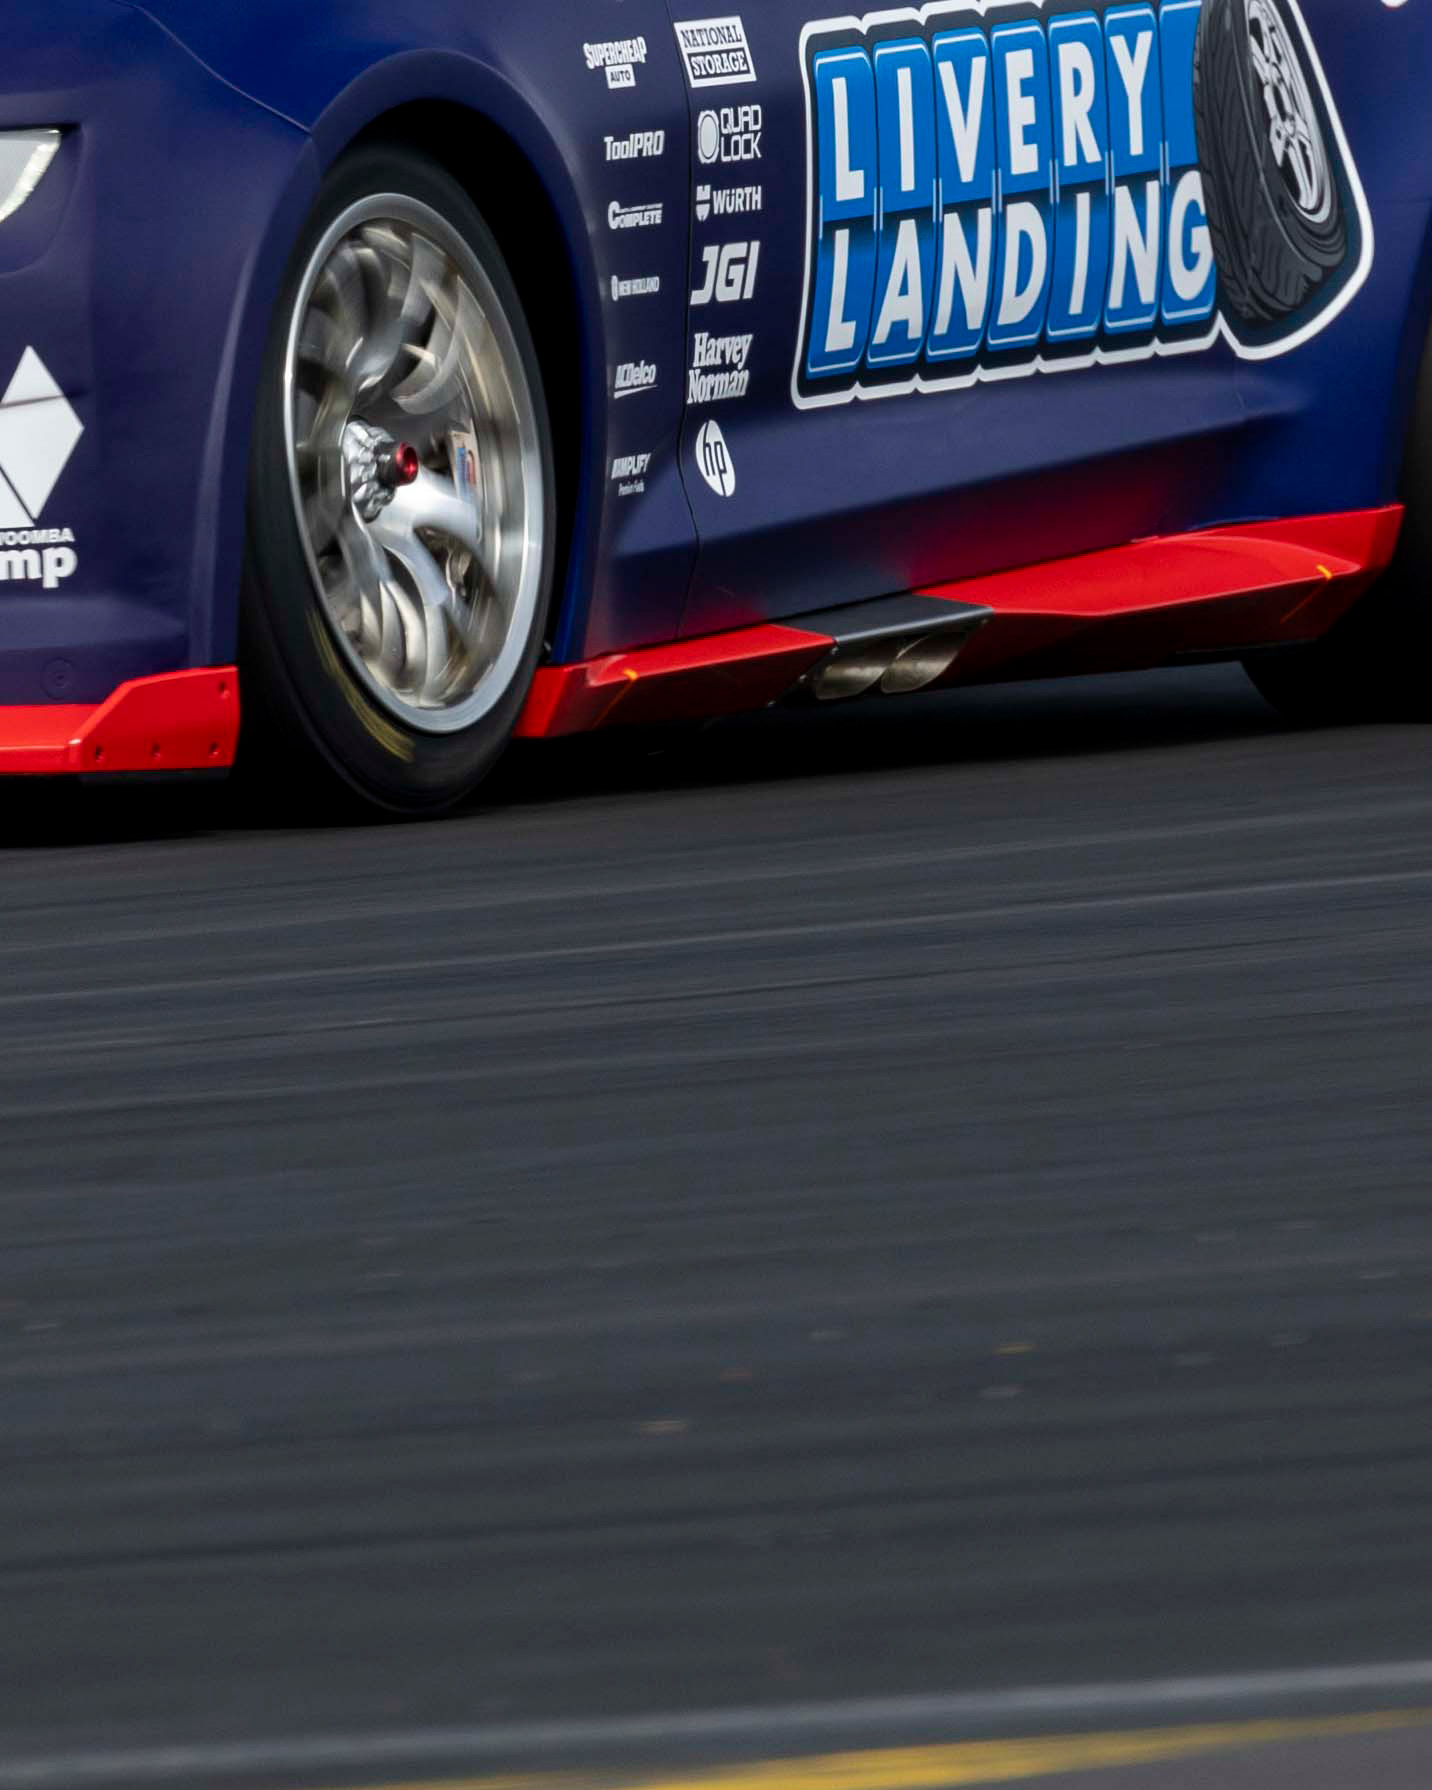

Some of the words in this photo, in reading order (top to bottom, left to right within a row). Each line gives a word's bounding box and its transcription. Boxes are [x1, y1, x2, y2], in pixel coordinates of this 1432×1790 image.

[583, 36, 647, 69] SUPERCHEAP
[680, 25, 742, 48] NATIONAL
[610, 69, 632, 83] AUTO
[690, 51, 749, 77] STORAGE
[720, 105, 762, 135] QUAD
[832, 30, 1154, 202] LIVERY
[604, 130, 665, 161] ToolPRO
[720, 131, 762, 162] LOCK
[690, 240, 760, 305] JGI
[824, 170, 1215, 353] LANDING
[692, 332, 753, 368] Harvey
[687, 368, 749, 404] Norman
